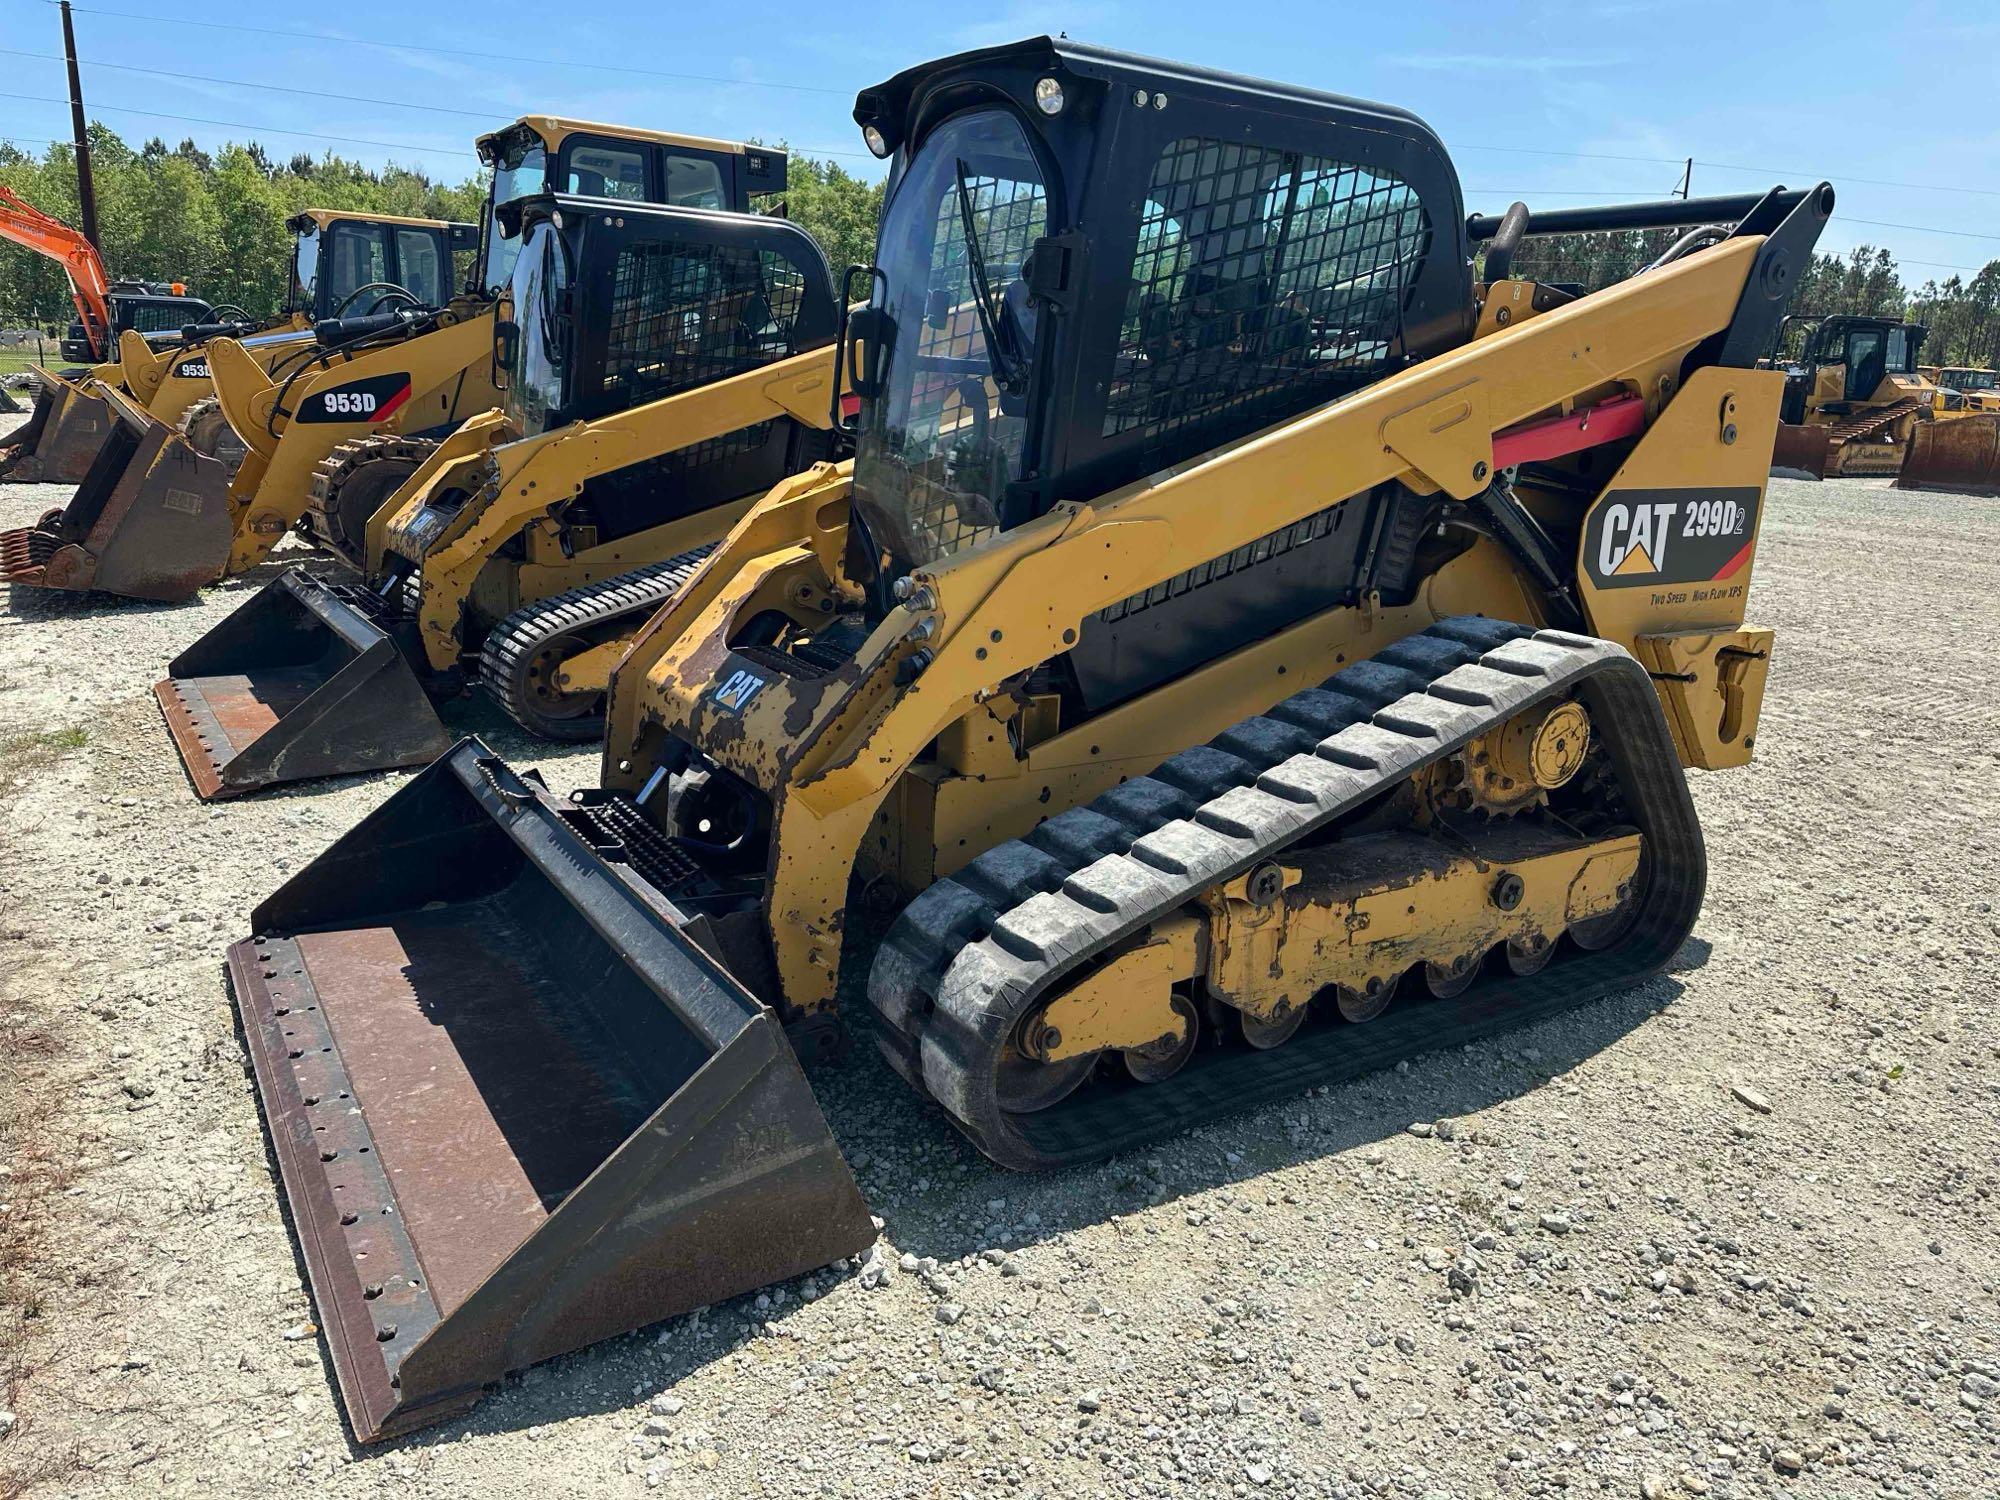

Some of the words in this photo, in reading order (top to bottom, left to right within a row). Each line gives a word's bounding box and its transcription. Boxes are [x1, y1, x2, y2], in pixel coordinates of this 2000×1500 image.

[10, 219, 46, 240] HITACHI
[324, 393, 376, 413] 953D
[1598, 503, 1678, 576] CAT
[1728, 586, 1743, 598] XPS
[715, 670, 765, 711] CAT
